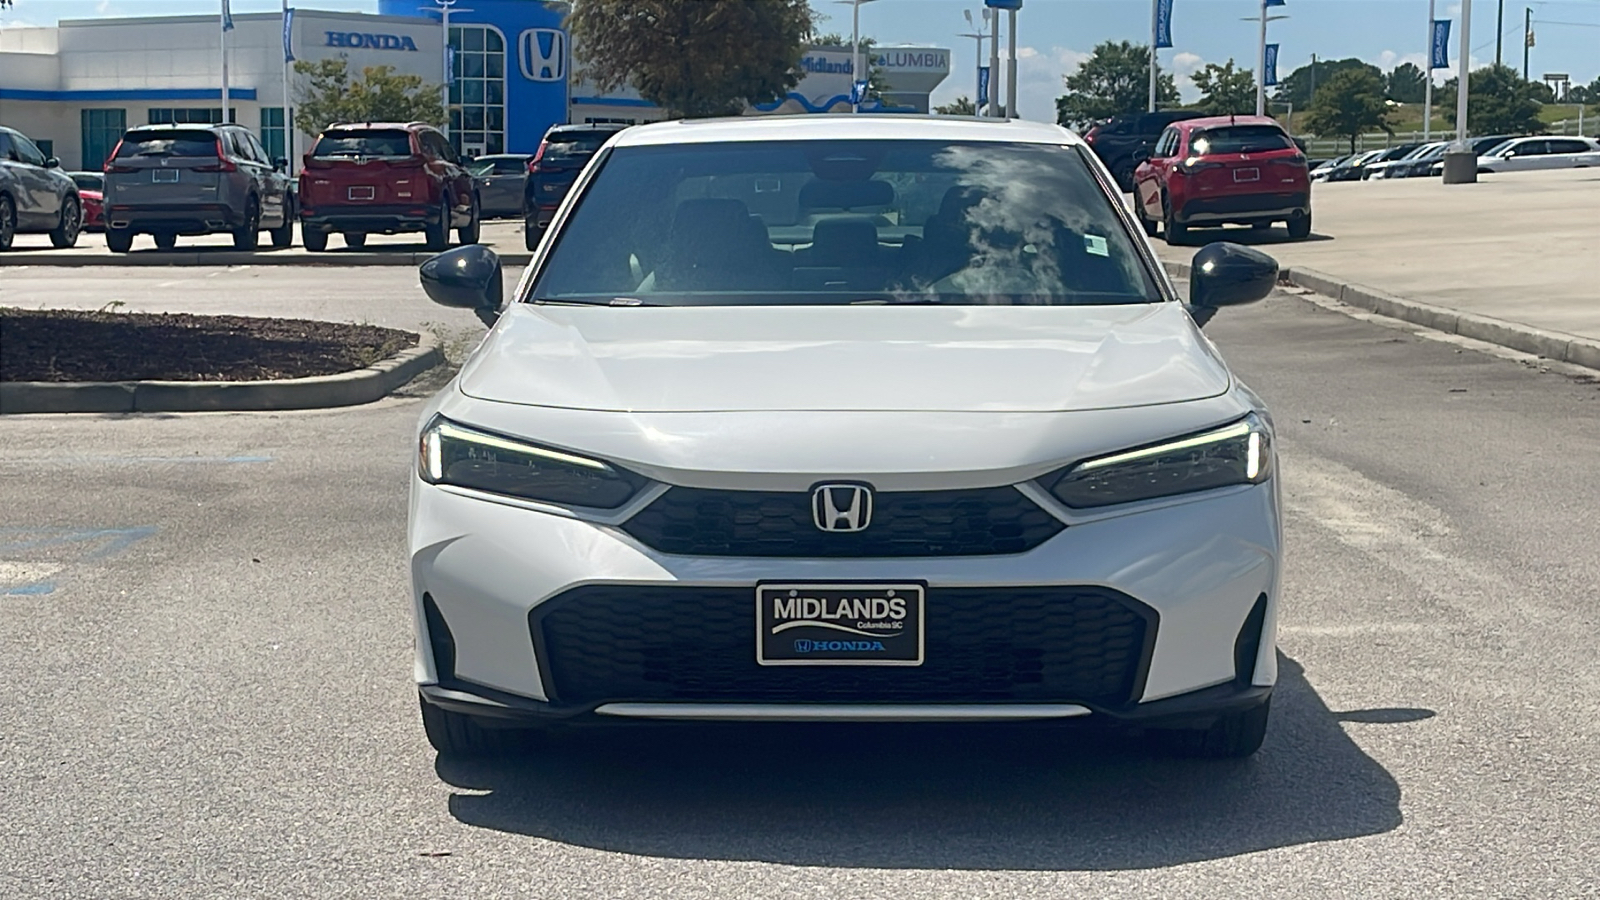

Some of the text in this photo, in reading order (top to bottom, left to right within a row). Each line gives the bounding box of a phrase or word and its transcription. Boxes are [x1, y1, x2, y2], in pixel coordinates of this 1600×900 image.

[324, 31, 418, 51] HONDA
[800, 57, 854, 75] Midland
[773, 598, 907, 620] MIDLANDS
[857, 621, 903, 629] Columbia SC
[813, 641, 886, 651] HONDA
